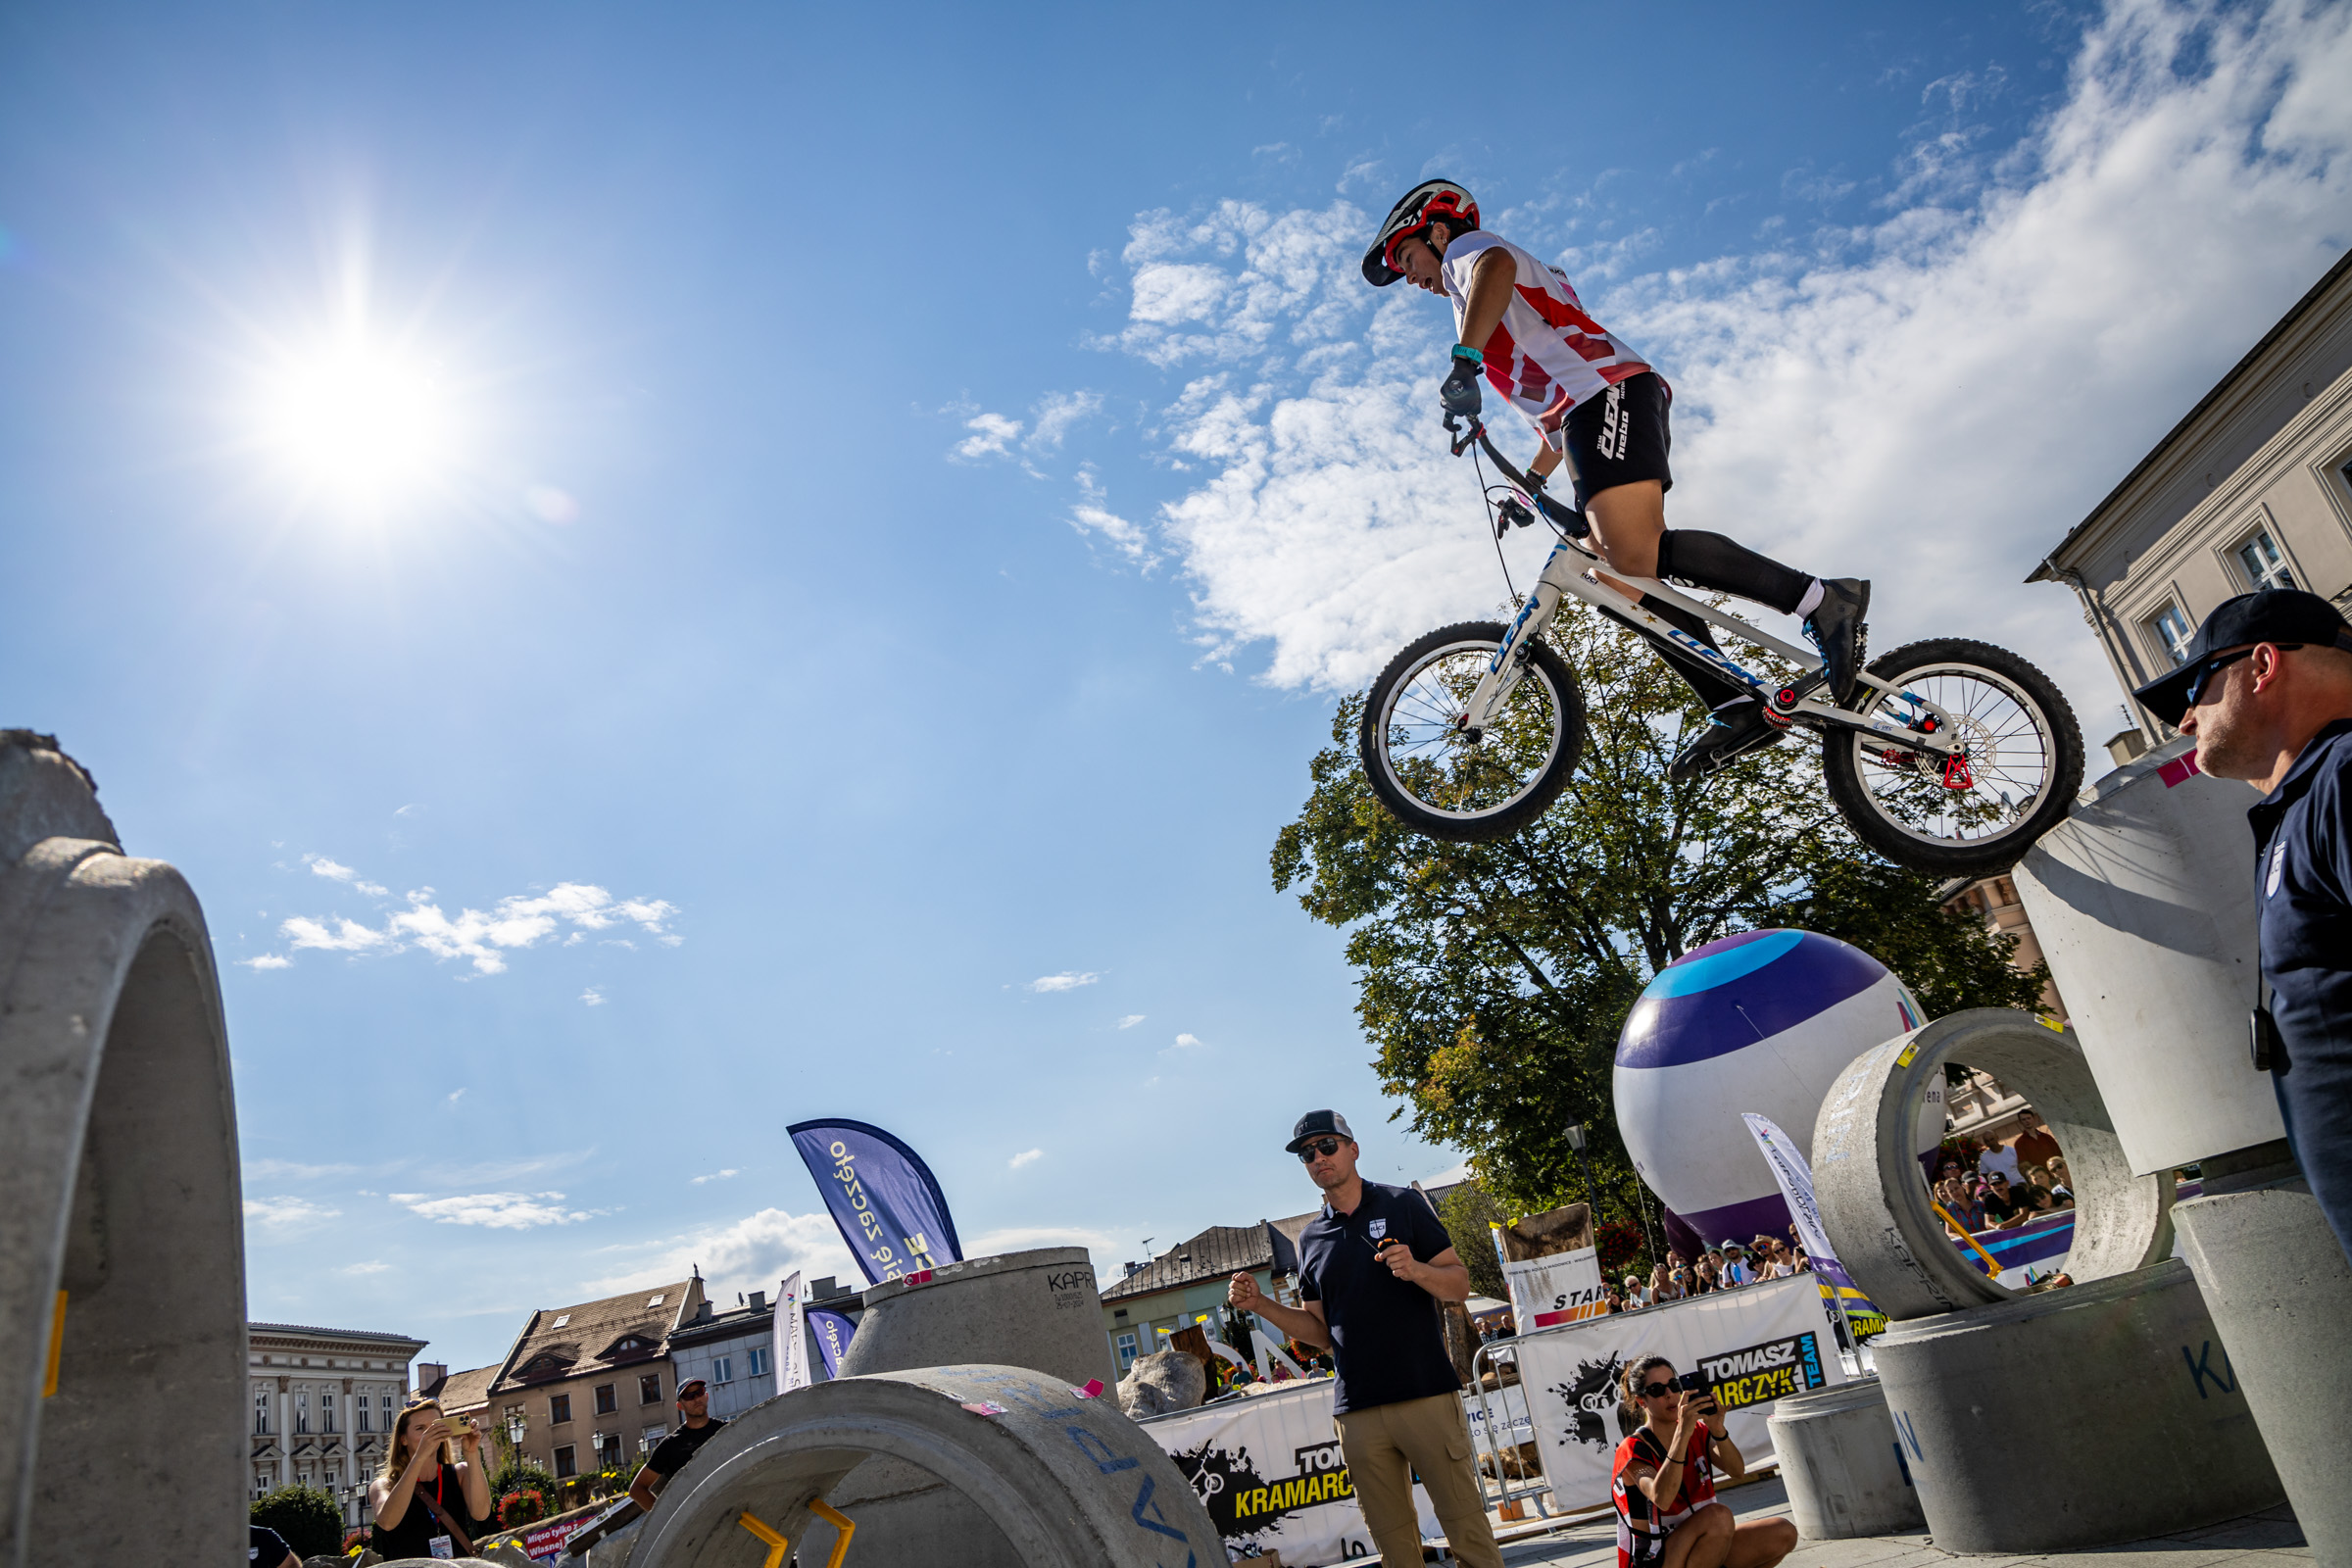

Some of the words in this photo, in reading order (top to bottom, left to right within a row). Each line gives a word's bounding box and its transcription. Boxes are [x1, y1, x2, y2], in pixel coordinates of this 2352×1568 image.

[1615, 410, 1629, 461] hebo
[1701, 1341, 1795, 1382] TOMASZ
[1800, 1334, 1822, 1388] TEAM
[527, 1531, 551, 1544] Mięso
[551, 1525, 572, 1538] tylko
[529, 1540, 564, 1556] Własnej
